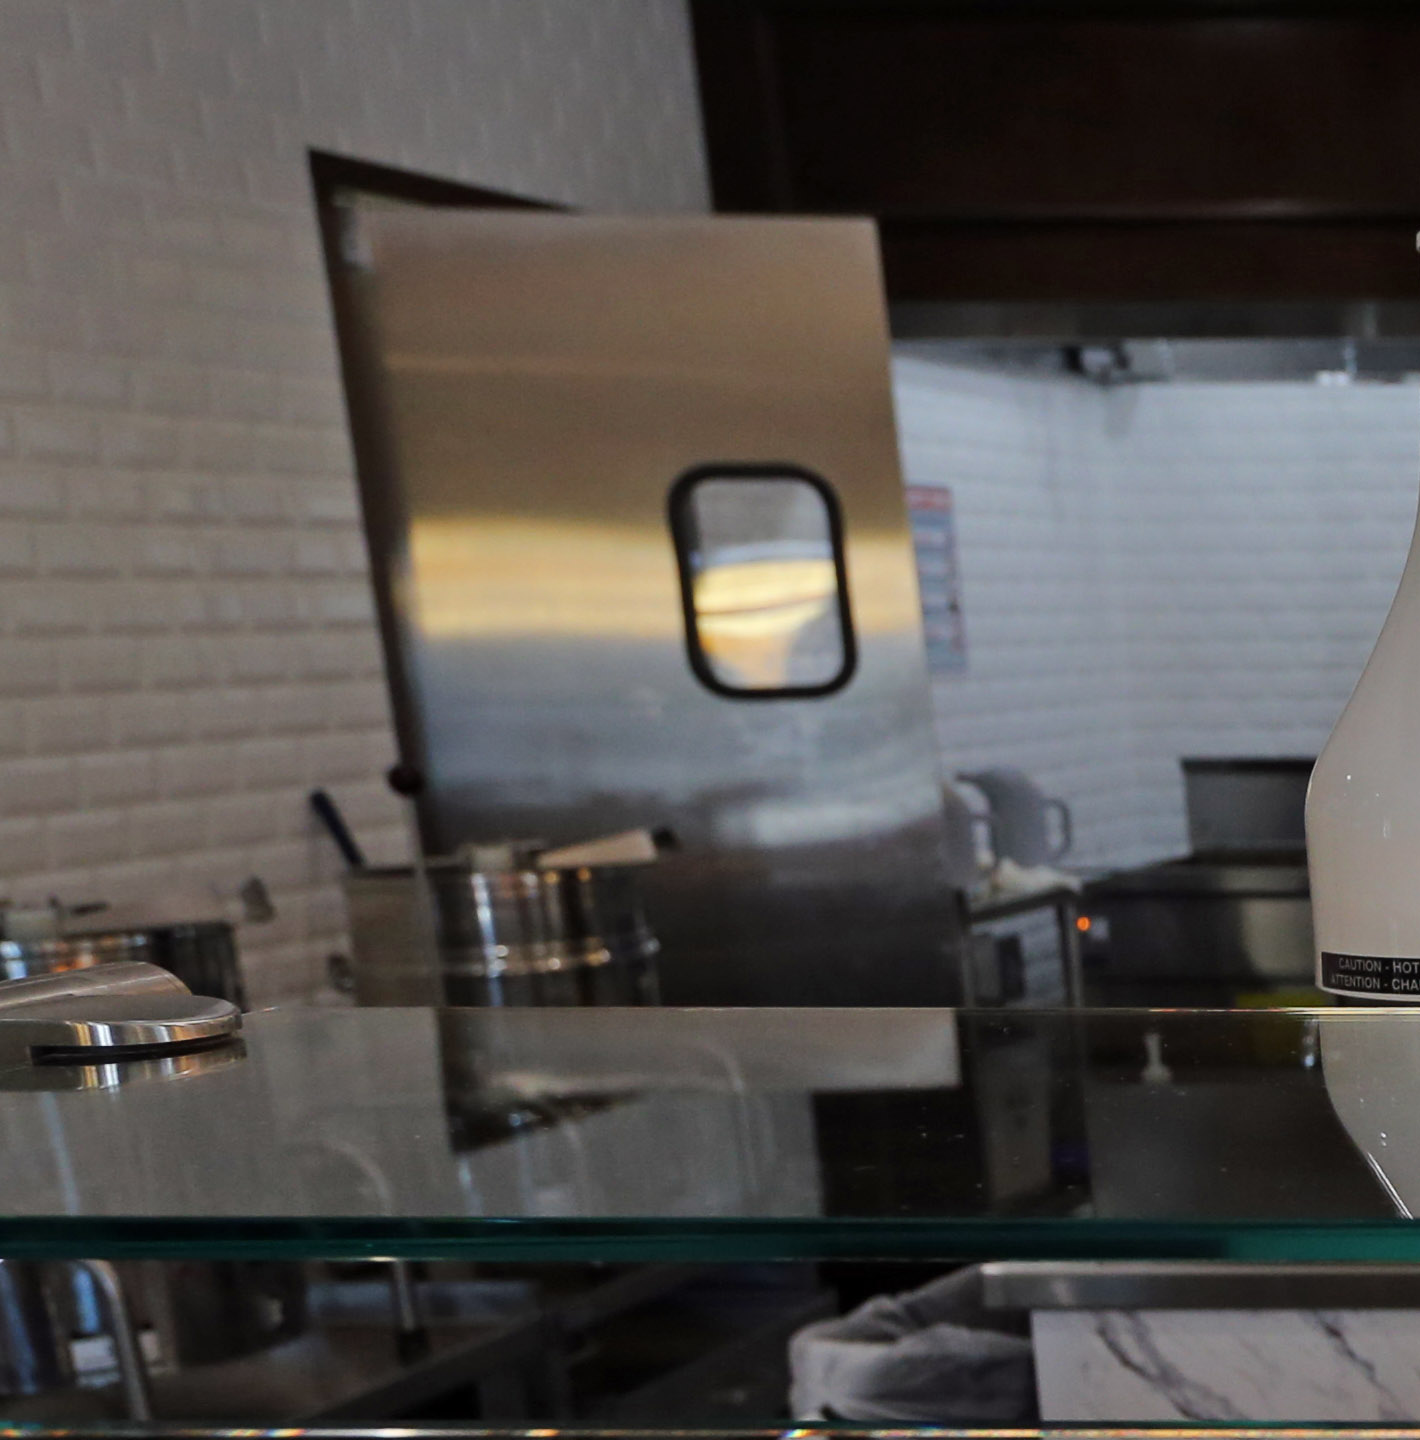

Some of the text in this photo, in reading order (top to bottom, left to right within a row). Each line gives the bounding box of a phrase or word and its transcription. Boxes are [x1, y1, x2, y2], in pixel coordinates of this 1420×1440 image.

[1339, 958, 1381, 973] CAUTION
[1393, 961, 1420, 974] HOT
[1331, 974, 1380, 989] ATTENTION
